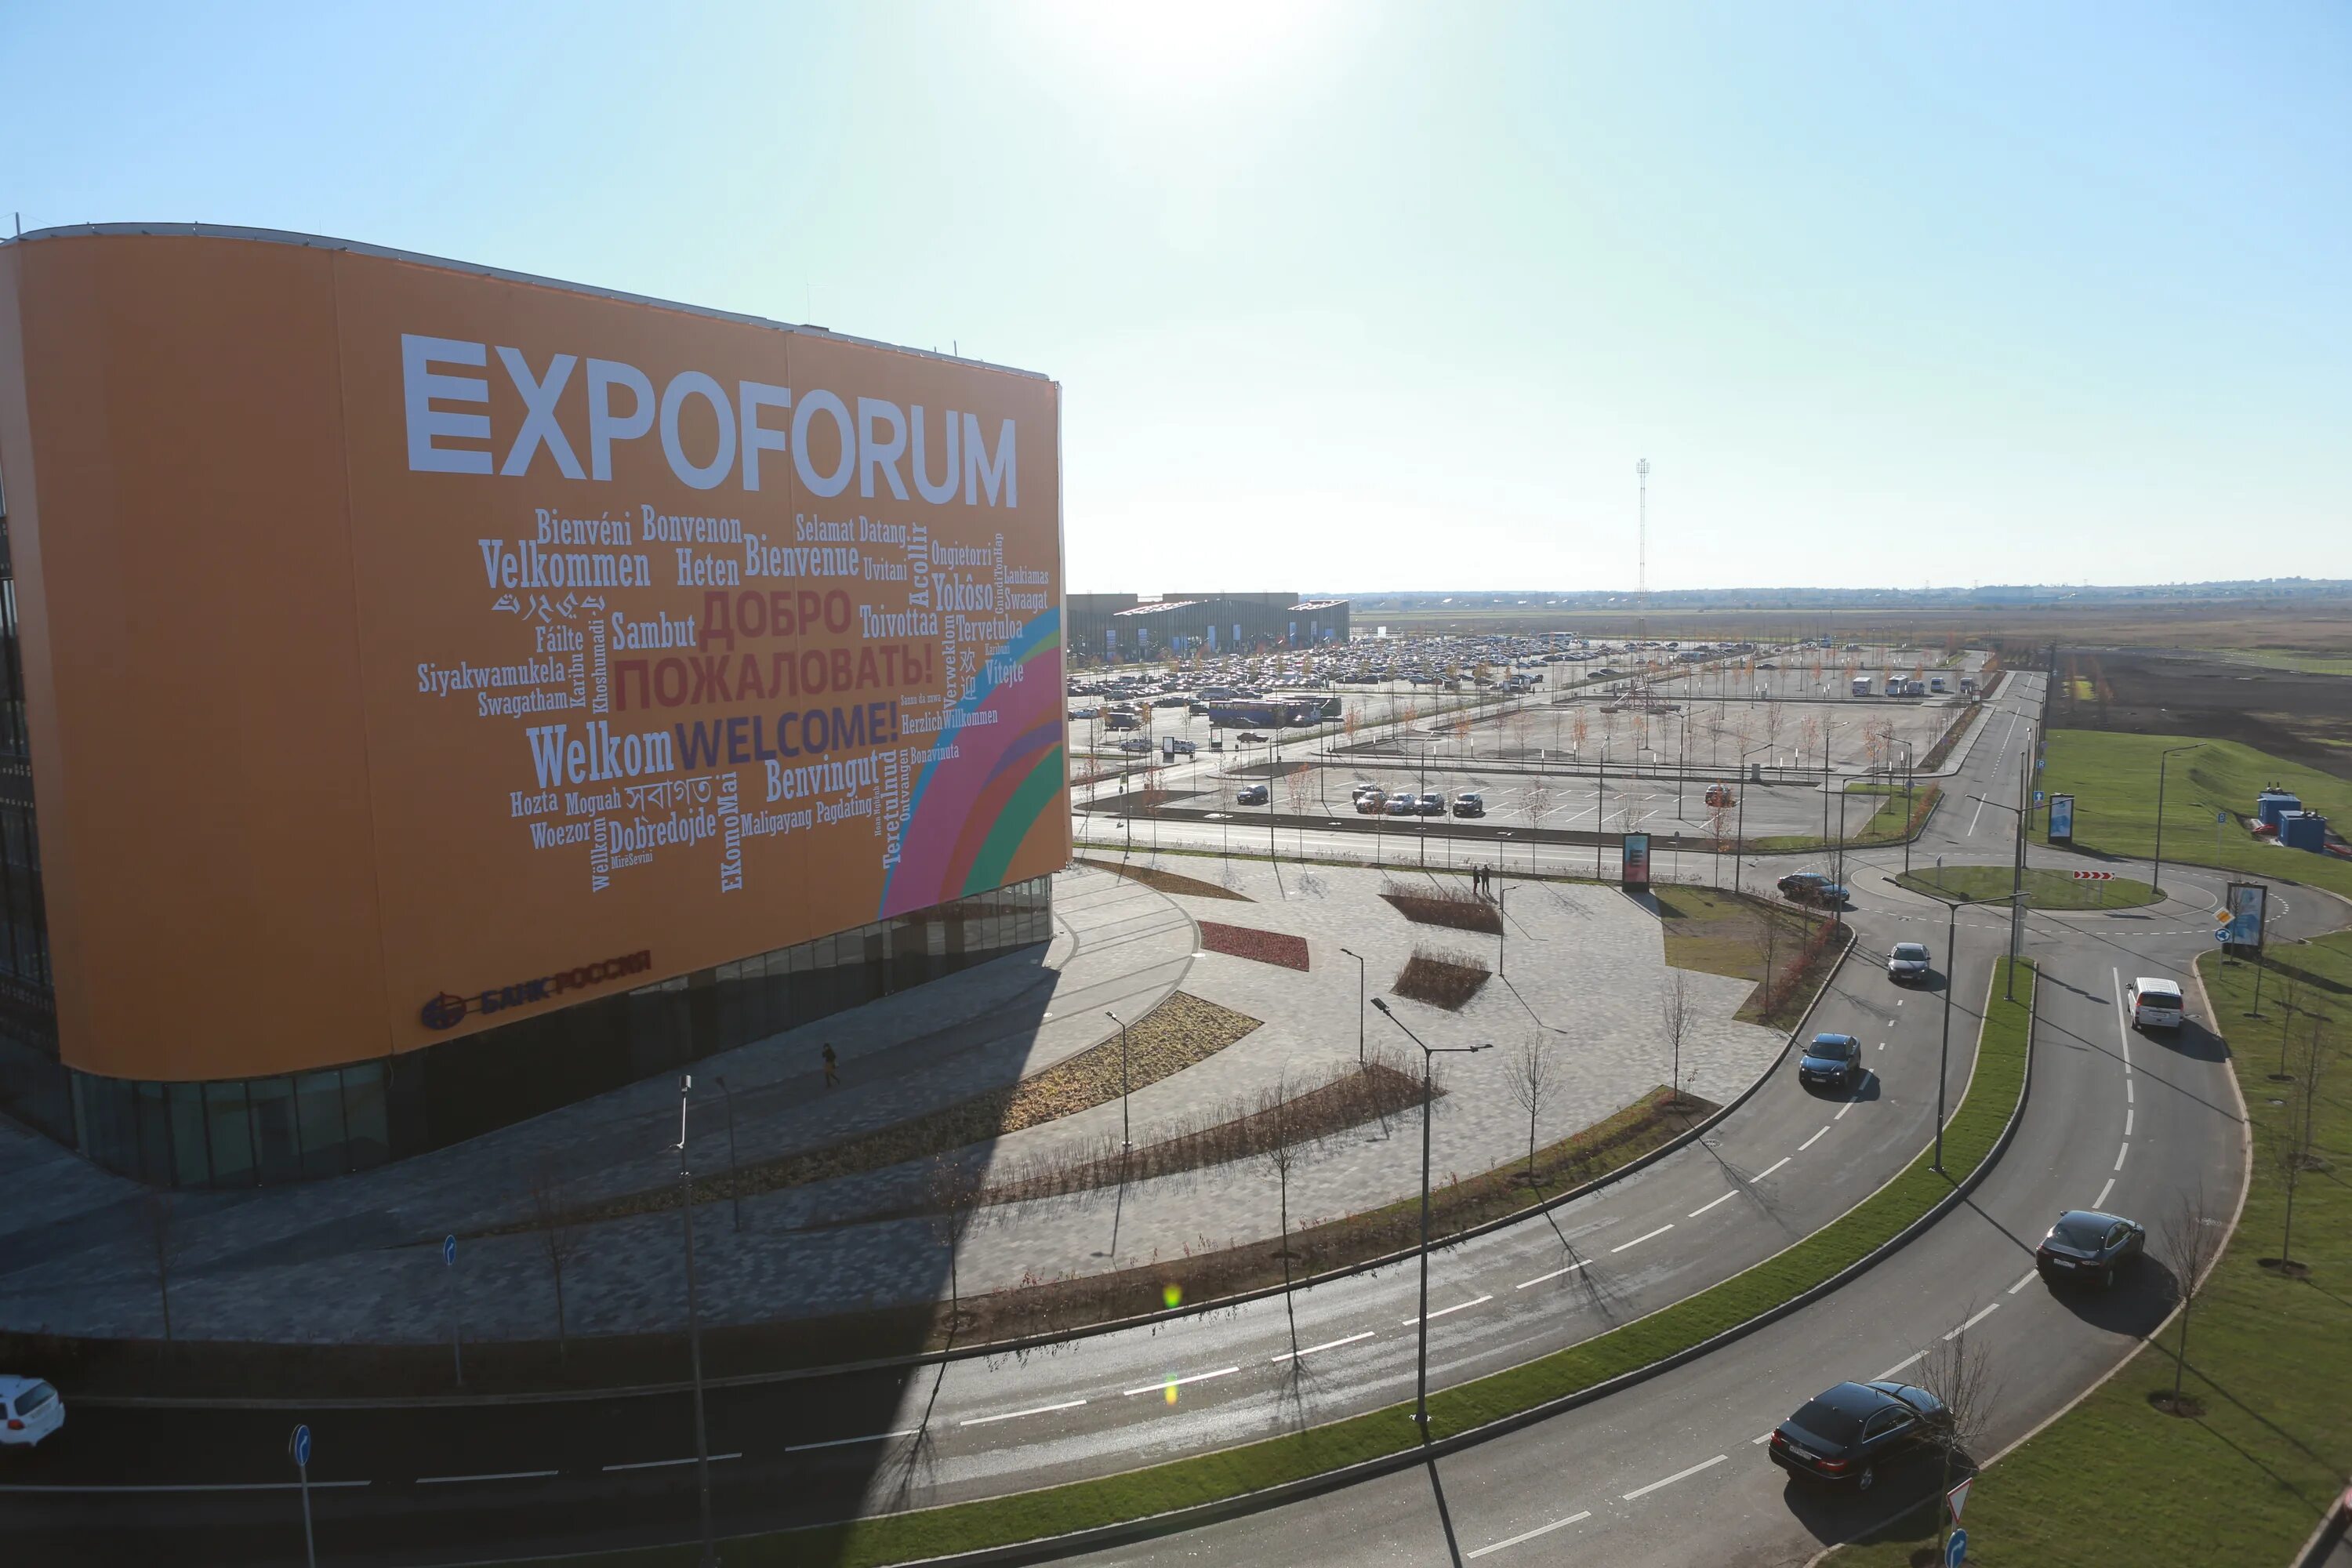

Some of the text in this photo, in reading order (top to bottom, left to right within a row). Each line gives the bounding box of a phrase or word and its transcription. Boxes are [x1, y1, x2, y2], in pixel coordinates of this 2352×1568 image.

[401, 333, 1018, 508] EXPOFORUM
[535, 508, 632, 545] Bienvéni
[641, 504, 742, 543] Bonvenon
[796, 514, 906, 548] Selamat Datang
[478, 539, 651, 589] Velkommen
[676, 548, 740, 586] Heten
[742, 534, 859, 577] Bienvenue
[863, 557, 908, 581] Uvitani
[908, 522, 928, 608] Acollir
[931, 539, 992, 571] Ongietorri
[1004, 564, 1049, 584] Laukiamas
[931, 572, 993, 612] Yokôso
[1004, 587, 1048, 614] Swaagat
[535, 626, 583, 653] Fáilte
[612, 612, 696, 650] Sambut
[699, 589, 852, 653] ДОБРО
[859, 604, 938, 639] Toivottaa
[956, 614, 1023, 642] Tervetuloa
[417, 656, 566, 698] Siyakwamukela
[568, 652, 586, 709] Karibu
[589, 617, 608, 714] Khoshumadi
[614, 642, 934, 712] ПОЖАЛОВАТЬ!
[942, 615, 956, 710] Verweklom
[985, 657, 1024, 688] Vítejte
[477, 688, 569, 719] Swagatham
[526, 720, 674, 789] Welkom
[674, 700, 898, 771] WELCOME!
[764, 749, 880, 802] Benvingut
[899, 749, 911, 822] Ontvangen
[510, 791, 558, 817] Hozta
[565, 787, 622, 817] Moguah
[740, 796, 873, 837] Maligayang Pagdating
[879, 749, 901, 869] Teretulnud
[530, 822, 591, 850] Woezor
[590, 817, 610, 892] Wëllkom
[481, 949, 652, 1014] БАНК РОССИЯ
